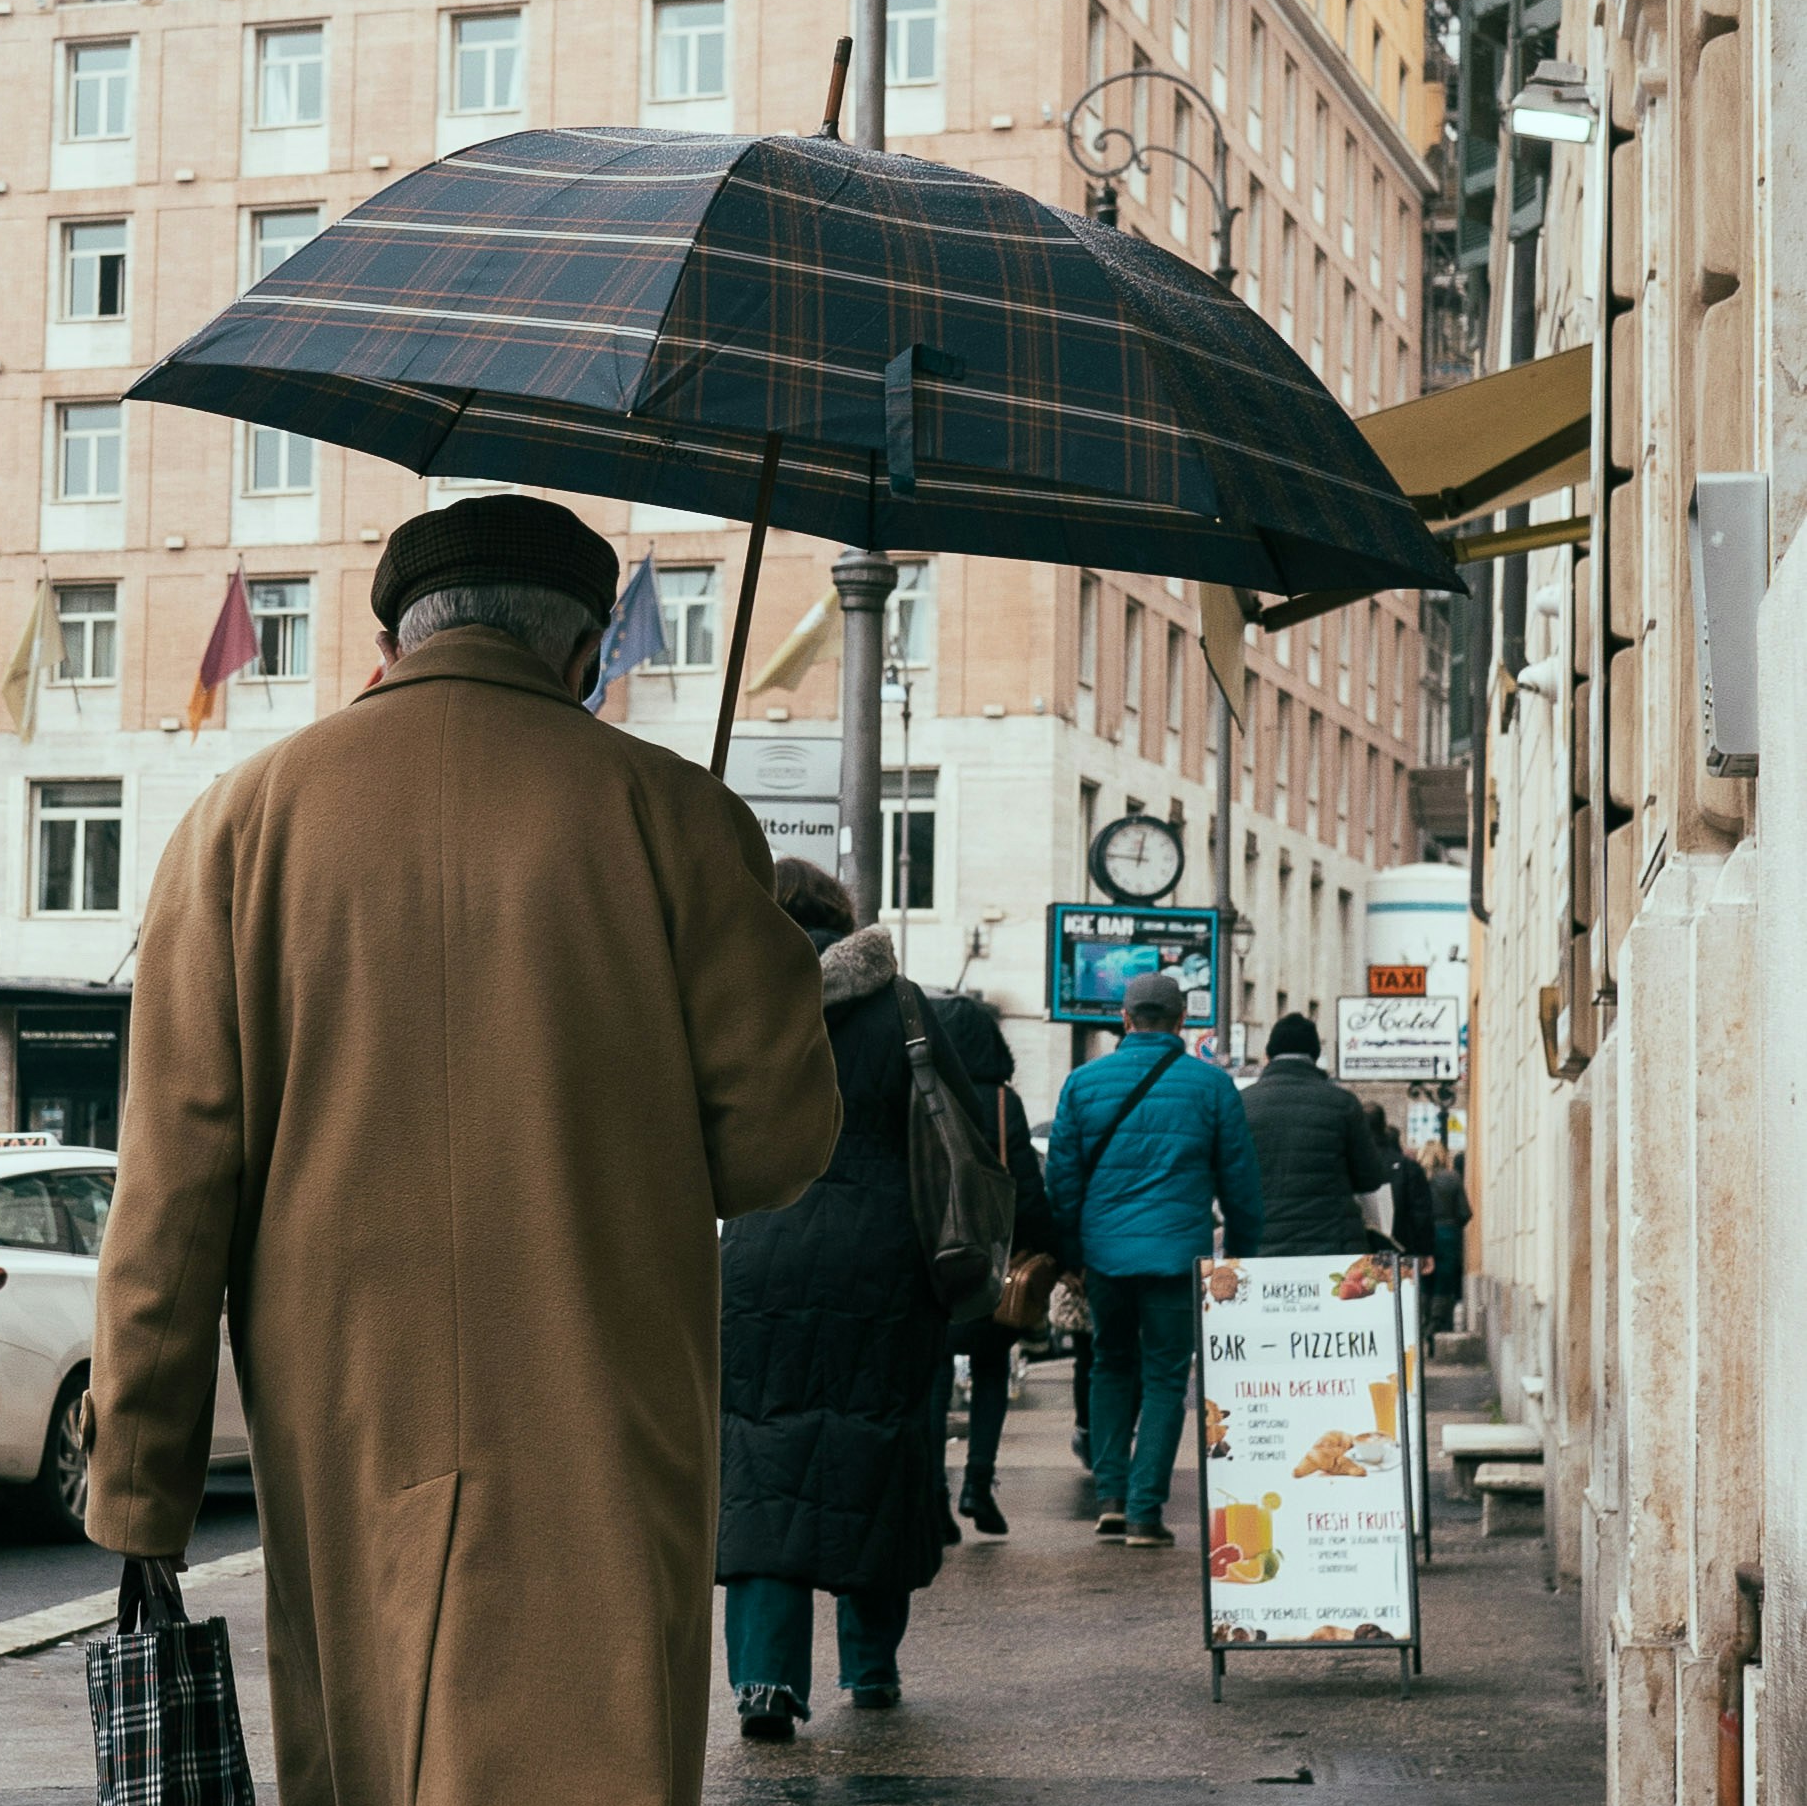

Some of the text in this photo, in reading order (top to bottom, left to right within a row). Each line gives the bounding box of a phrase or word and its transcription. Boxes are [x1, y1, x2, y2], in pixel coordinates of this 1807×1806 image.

[758, 819, 834, 835] itorium
[1063, 915, 1095, 933] ICE
[1097, 915, 1135, 936] BAR
[1377, 972, 1422, 988] TAXI
[1347, 999, 1447, 1032] Hotel
[1210, 1333, 1246, 1362] BAR
[1290, 1330, 1378, 1359] PIZZERIA
[1235, 1378, 1355, 1398] ITALIAN BREAKFAST
[1307, 1510, 1406, 1531] FRESH FRUITS
